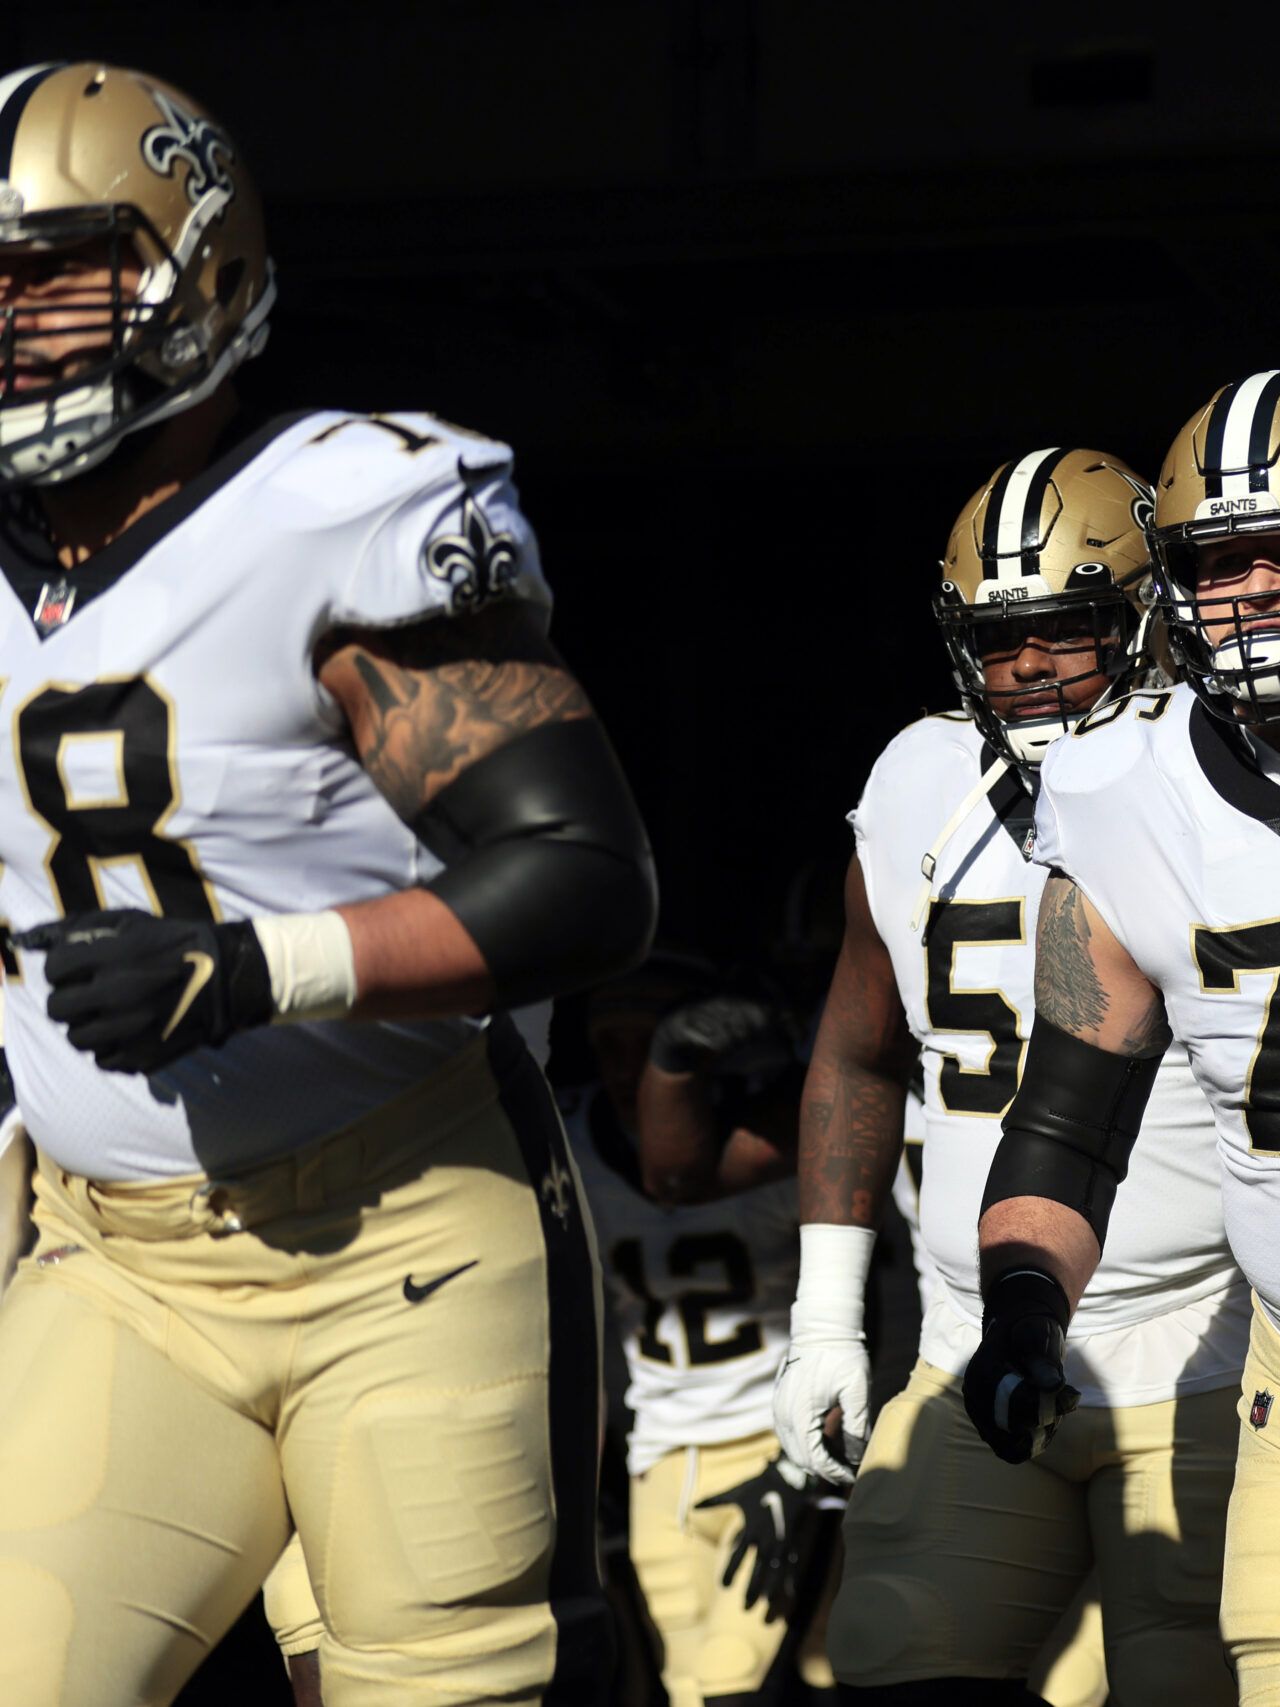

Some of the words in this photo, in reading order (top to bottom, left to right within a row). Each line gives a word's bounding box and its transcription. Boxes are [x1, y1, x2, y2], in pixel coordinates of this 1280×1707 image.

[1210, 498, 1257, 516] SAINTS
[988, 586, 1029, 603] SAINTS
[0, 668, 224, 928] 8
[924, 896, 1027, 1118] 5
[613, 1230, 766, 1368] 12
